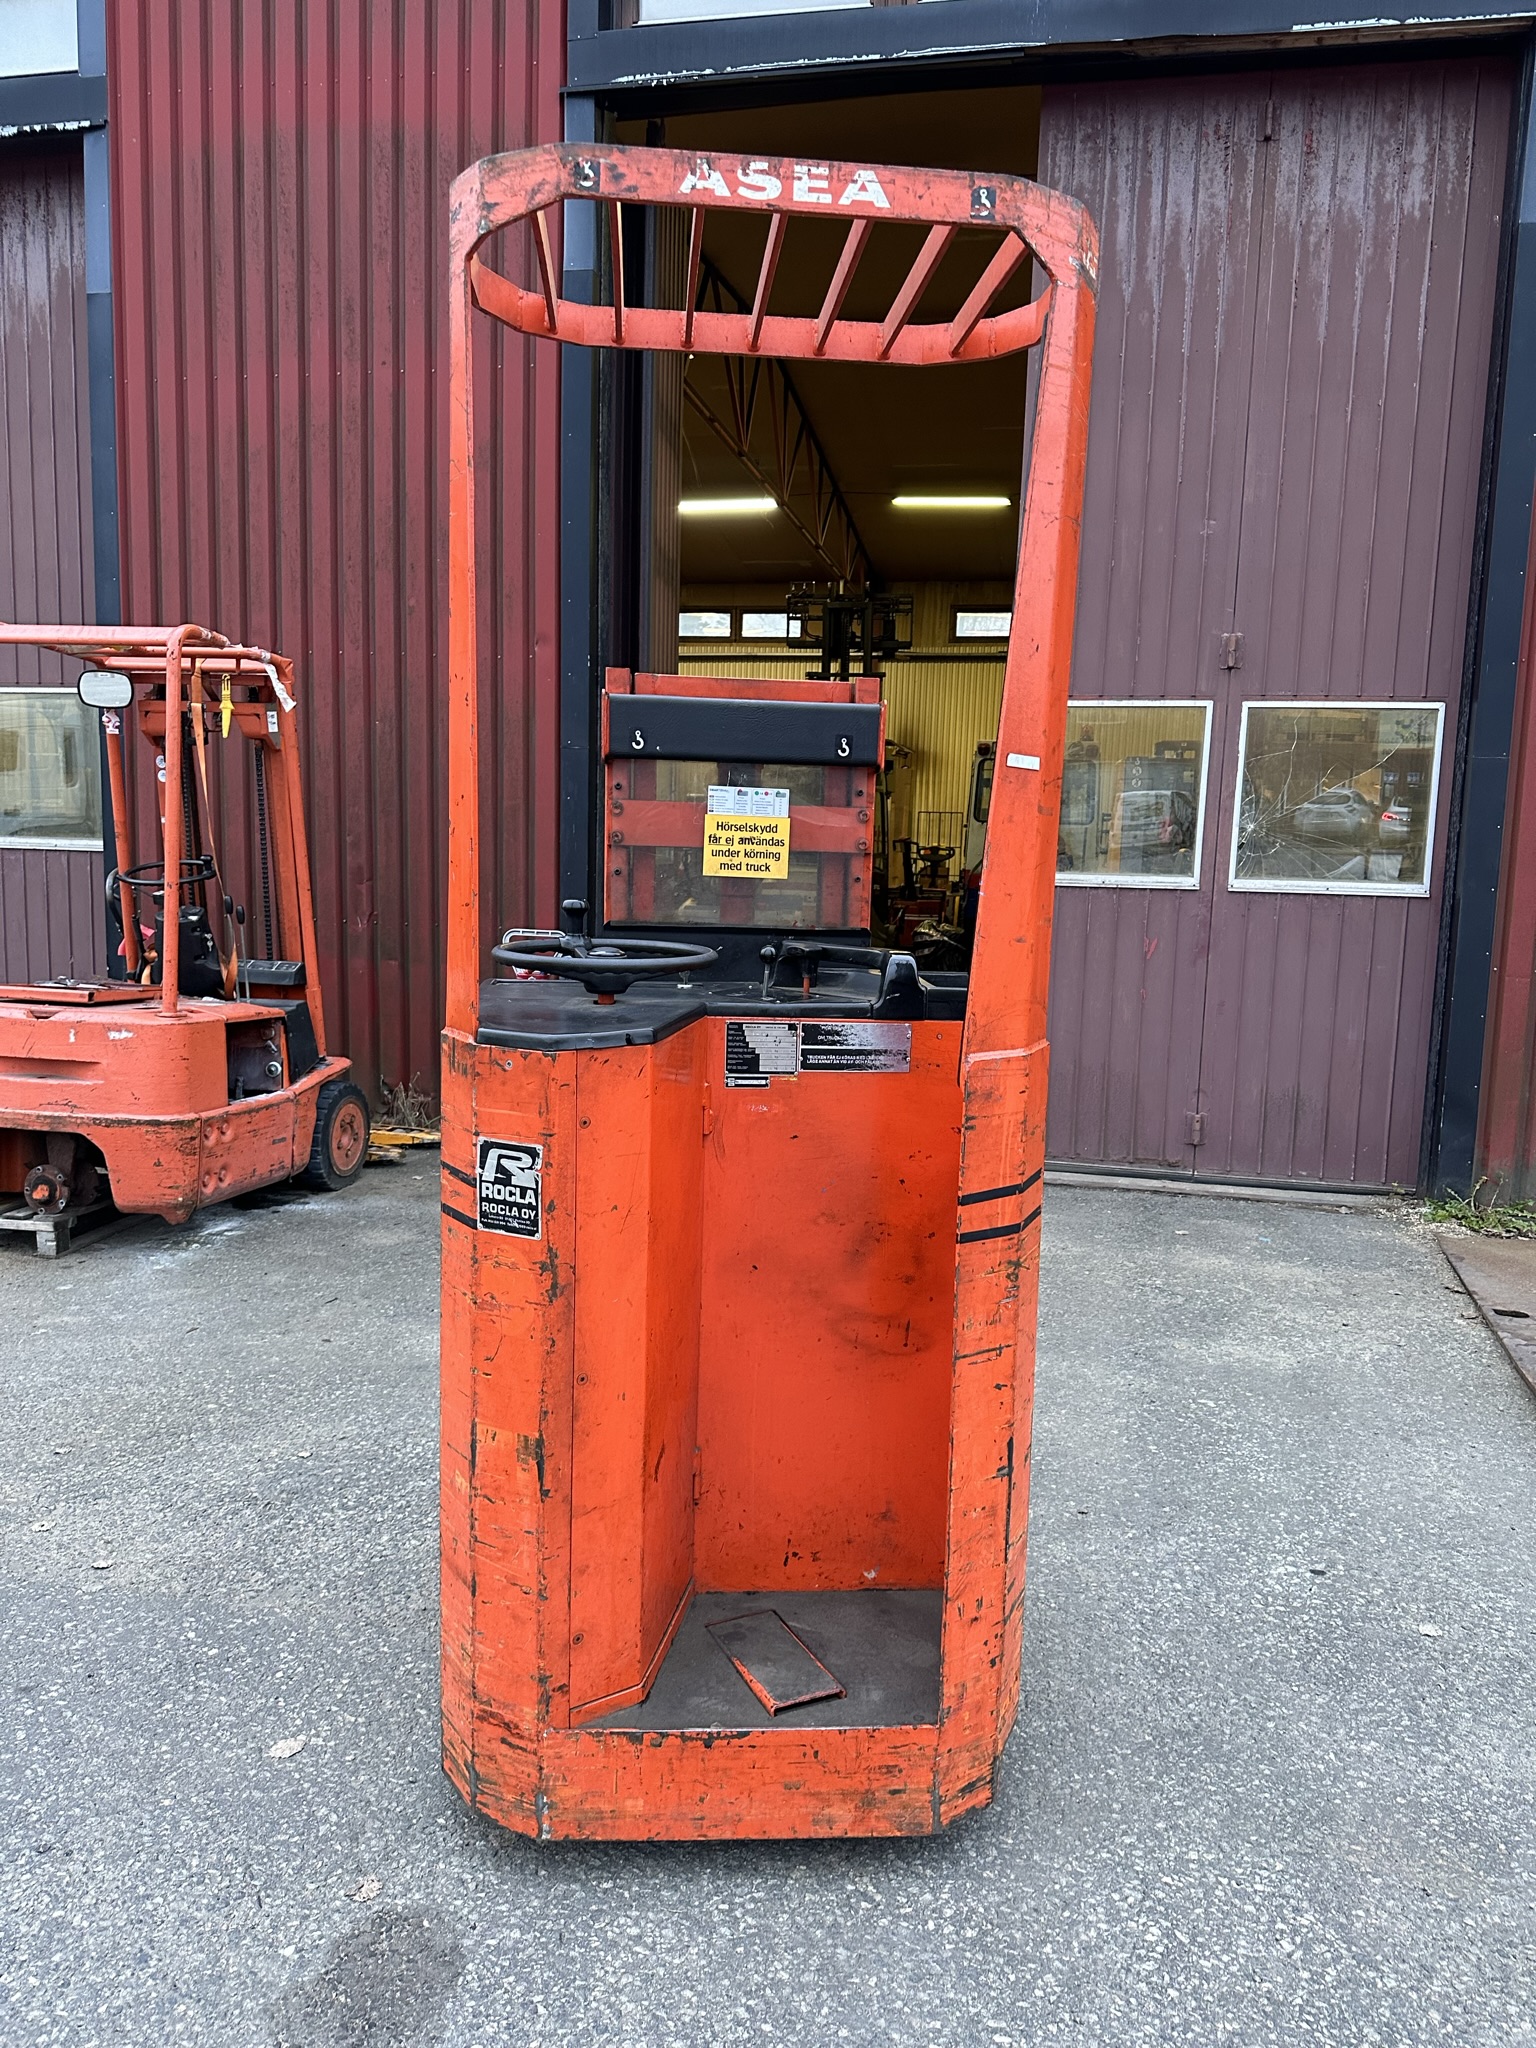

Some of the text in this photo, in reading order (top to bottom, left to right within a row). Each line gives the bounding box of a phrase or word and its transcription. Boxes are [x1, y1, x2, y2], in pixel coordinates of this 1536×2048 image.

[678, 158, 891, 209] ASEA
[716, 821, 778, 835] Hörselskydd
[708, 833, 785, 847] får ej användas
[711, 848, 781, 861] under körning
[720, 861, 771, 872] med truck
[481, 1182, 537, 1206] ROCLA
[481, 1202, 519, 1218] ROCLA
[521, 1209, 537, 1220] OY
